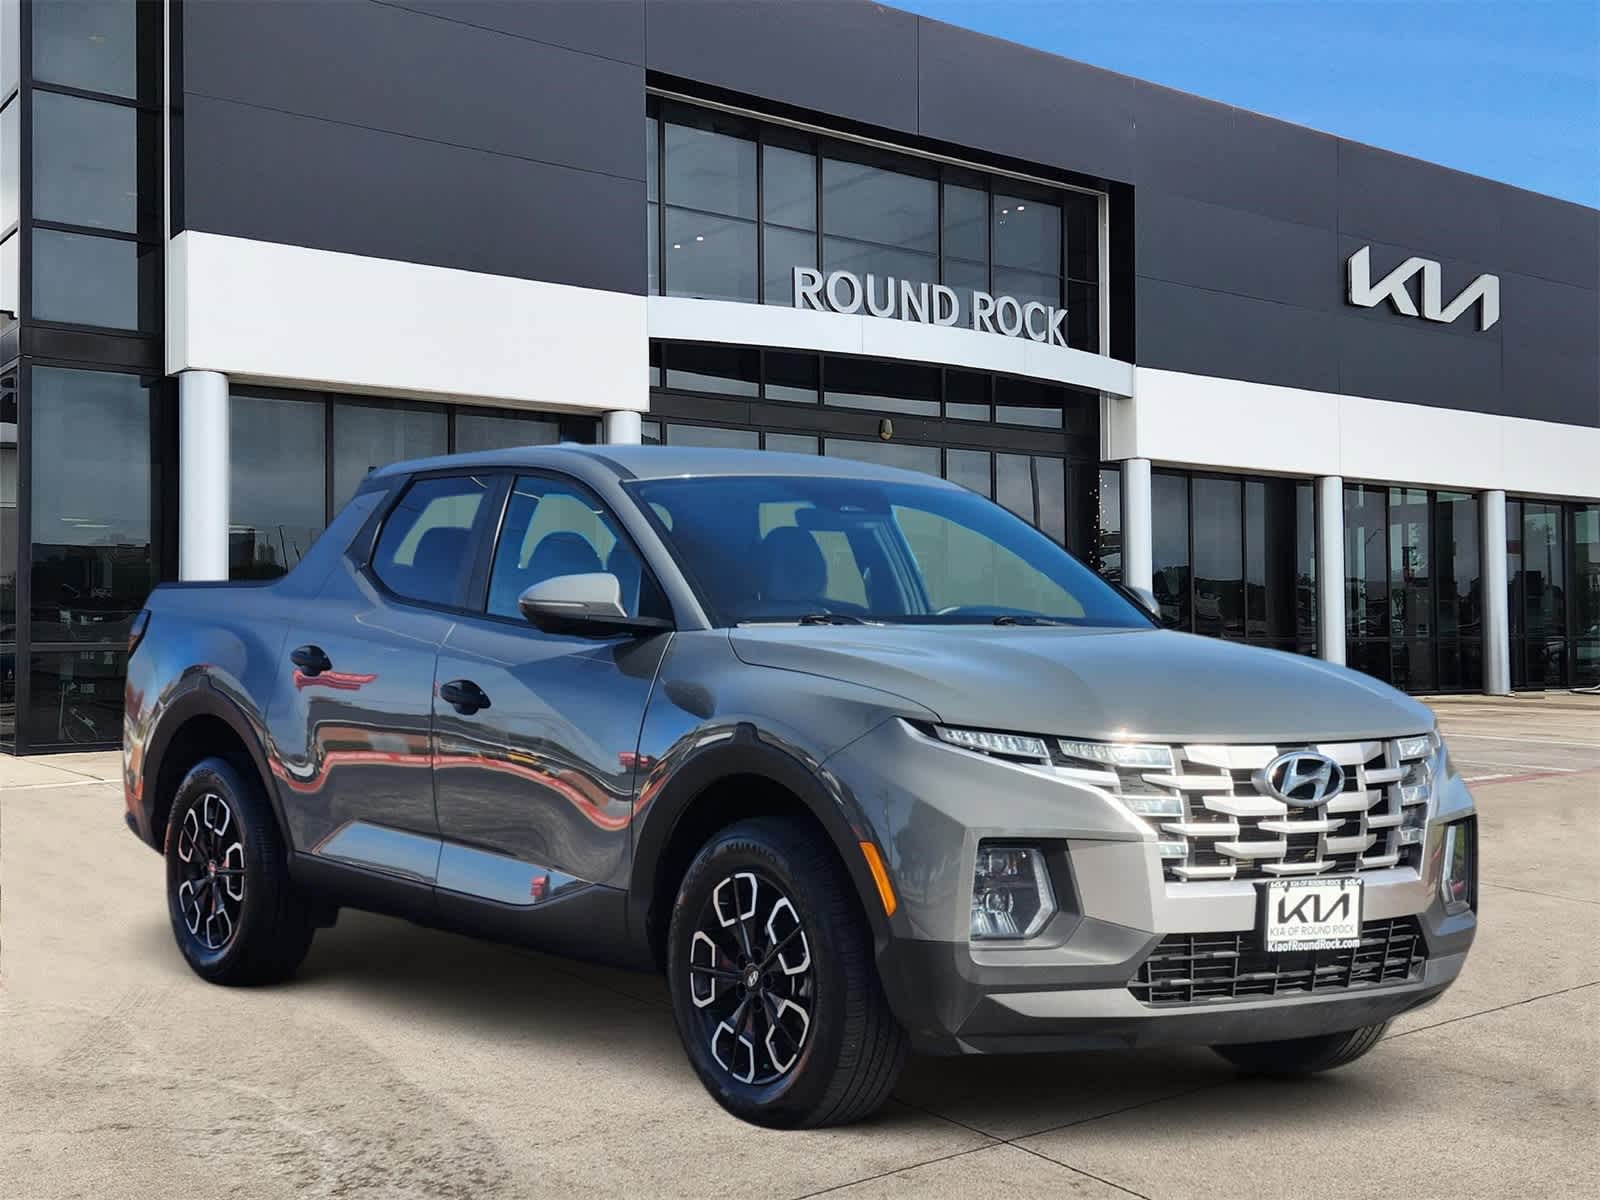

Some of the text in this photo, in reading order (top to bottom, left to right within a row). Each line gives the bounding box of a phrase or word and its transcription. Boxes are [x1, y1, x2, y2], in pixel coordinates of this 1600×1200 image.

[1347, 245, 1500, 331] KIA
[791, 265, 1069, 347] ROUND ROCK
[1277, 892, 1350, 924] KIA
[1267, 938, 1360, 952] KiaofRoundRock.com
[1270, 924, 1354, 937] KIA OF ROUND ROCK
